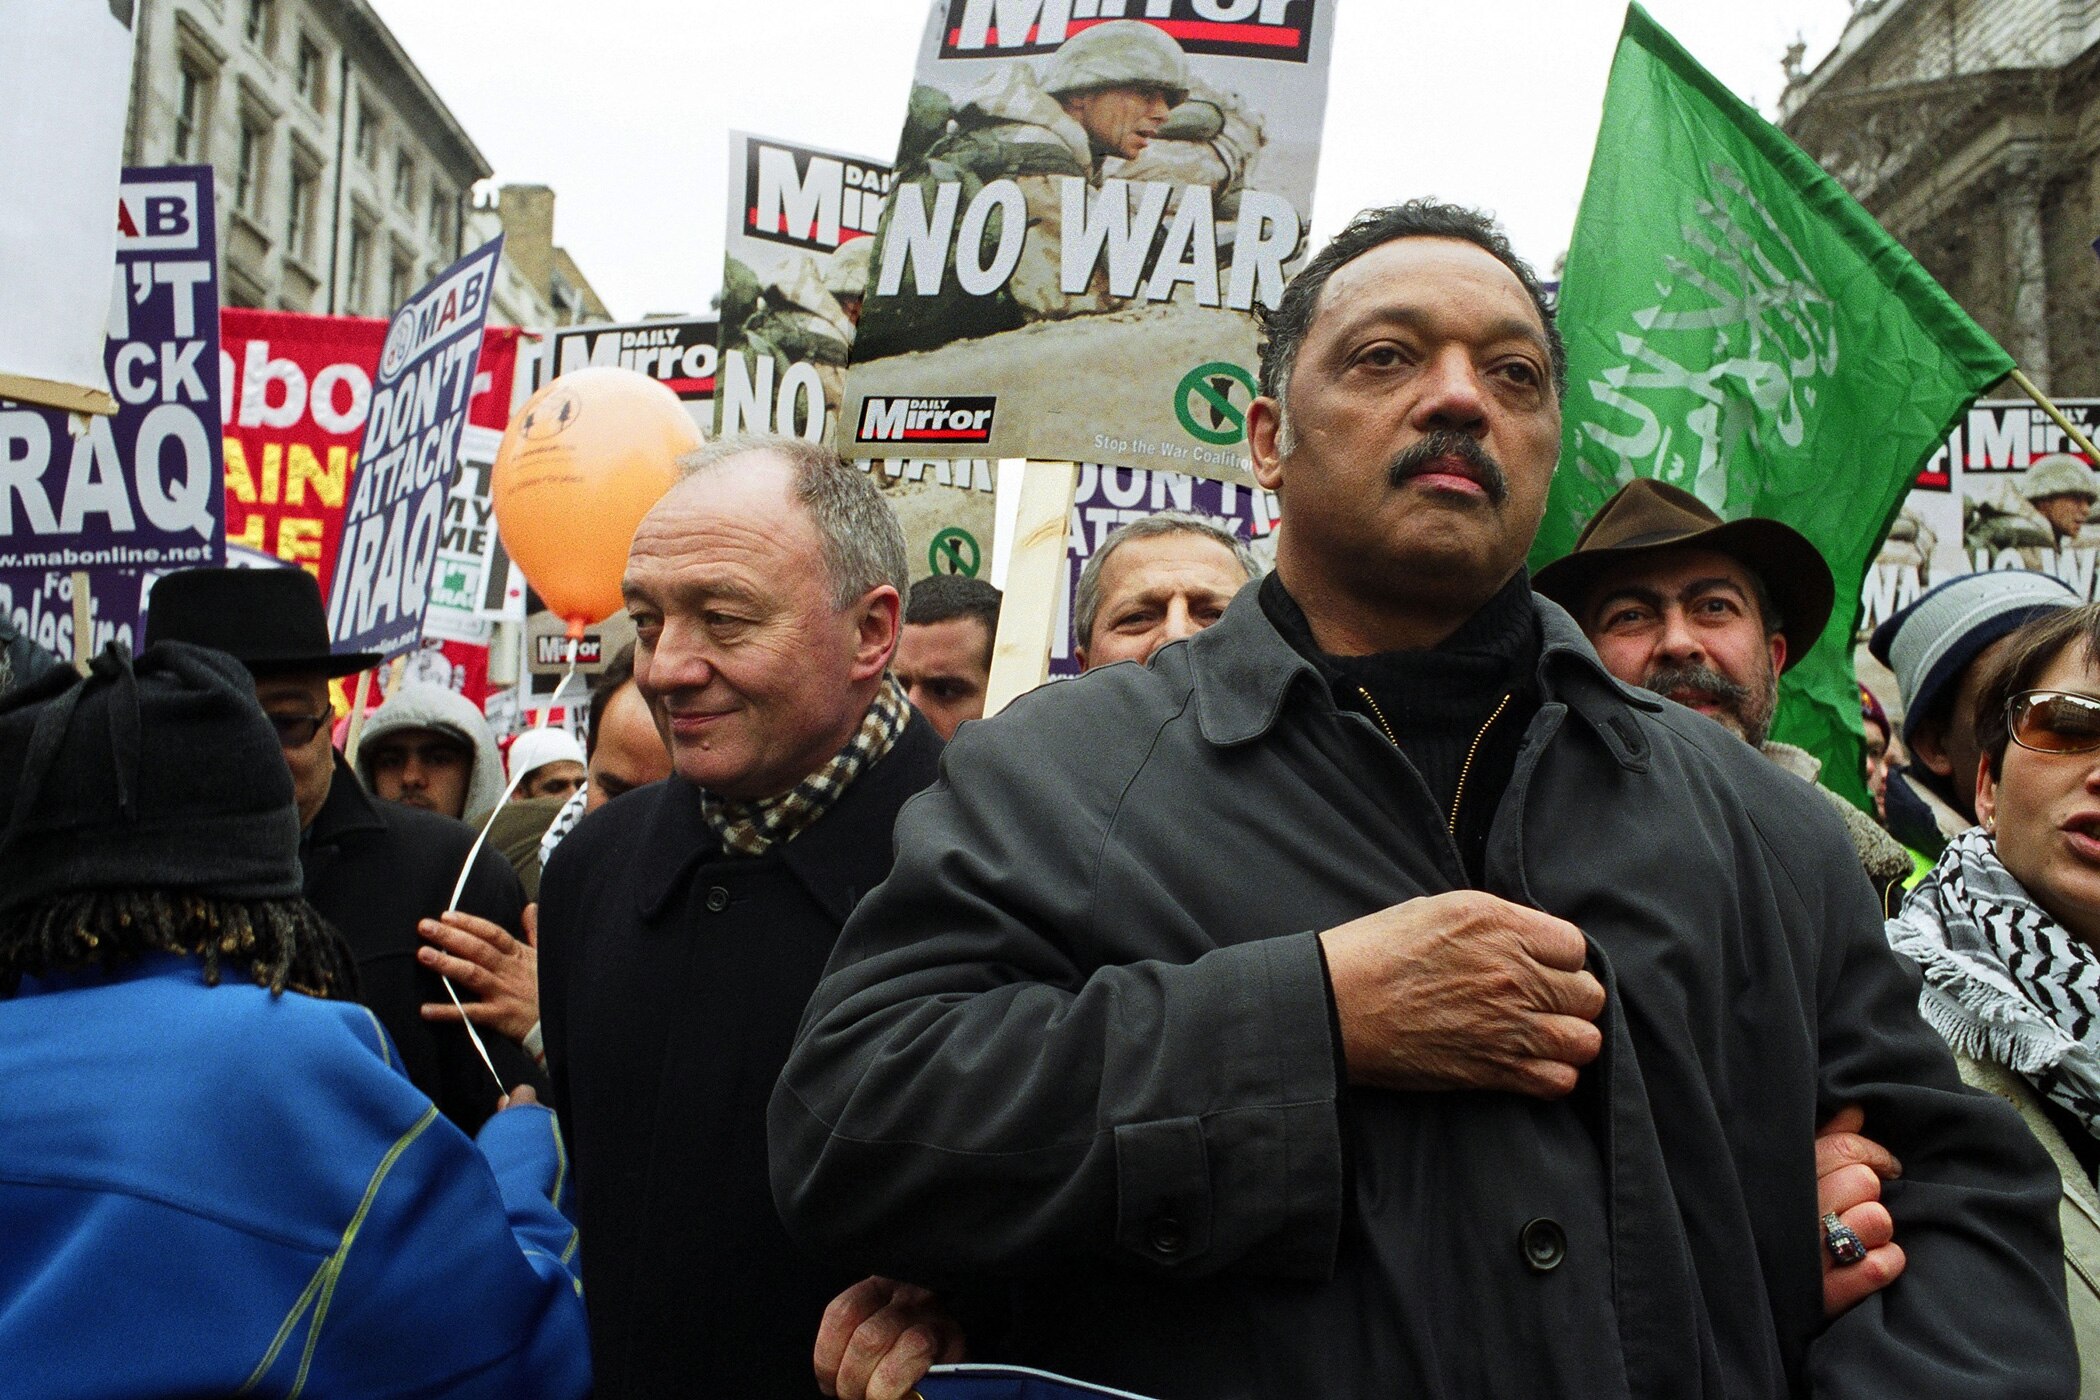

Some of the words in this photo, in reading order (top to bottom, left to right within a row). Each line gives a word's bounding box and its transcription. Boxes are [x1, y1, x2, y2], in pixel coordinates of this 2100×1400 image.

[756, 145, 887, 247] Mir
[845, 164, 893, 194] DAI
[876, 179, 1028, 297] NO
[1060, 177, 1299, 311] WAR
[415, 271, 484, 349] MAB
[622, 328, 681, 348] DAILY
[361, 327, 482, 464] DON'T
[560, 332, 718, 380] Mirro
[721, 349, 825, 444] NO
[862, 399, 991, 439] Mirror
[910, 400, 949, 409] DAILY
[1095, 434, 1127, 453] Stop
[1132, 439, 1155, 455] the
[1161, 442, 1189, 459] War
[0, 403, 215, 541] RAQ
[348, 410, 462, 523] ATTACK
[328, 480, 443, 645] IRAQ
